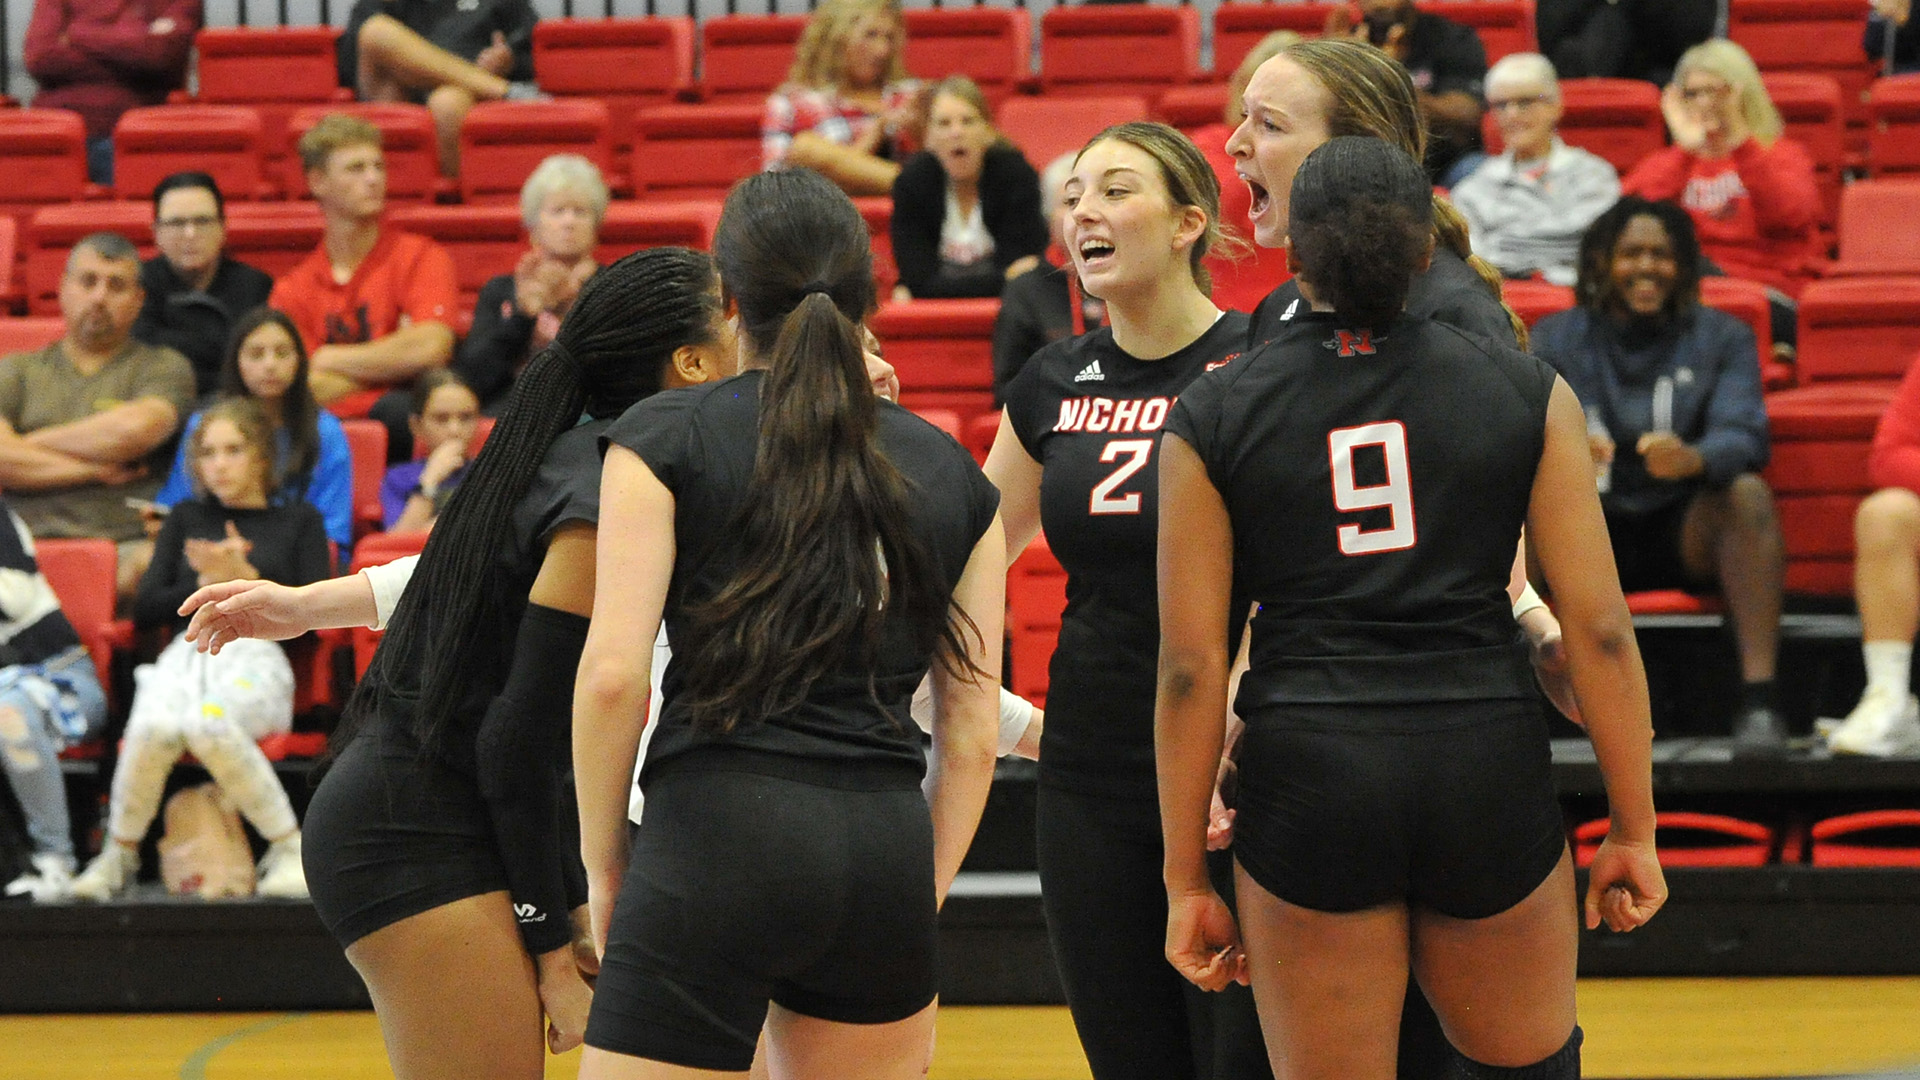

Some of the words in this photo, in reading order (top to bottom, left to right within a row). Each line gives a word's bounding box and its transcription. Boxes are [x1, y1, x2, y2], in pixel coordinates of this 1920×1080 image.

[1074, 372, 1105, 382] adidas
[1052, 395, 1178, 433] NICHO
[1089, 438, 1154, 516] 2
[1327, 419, 1417, 557] 9
